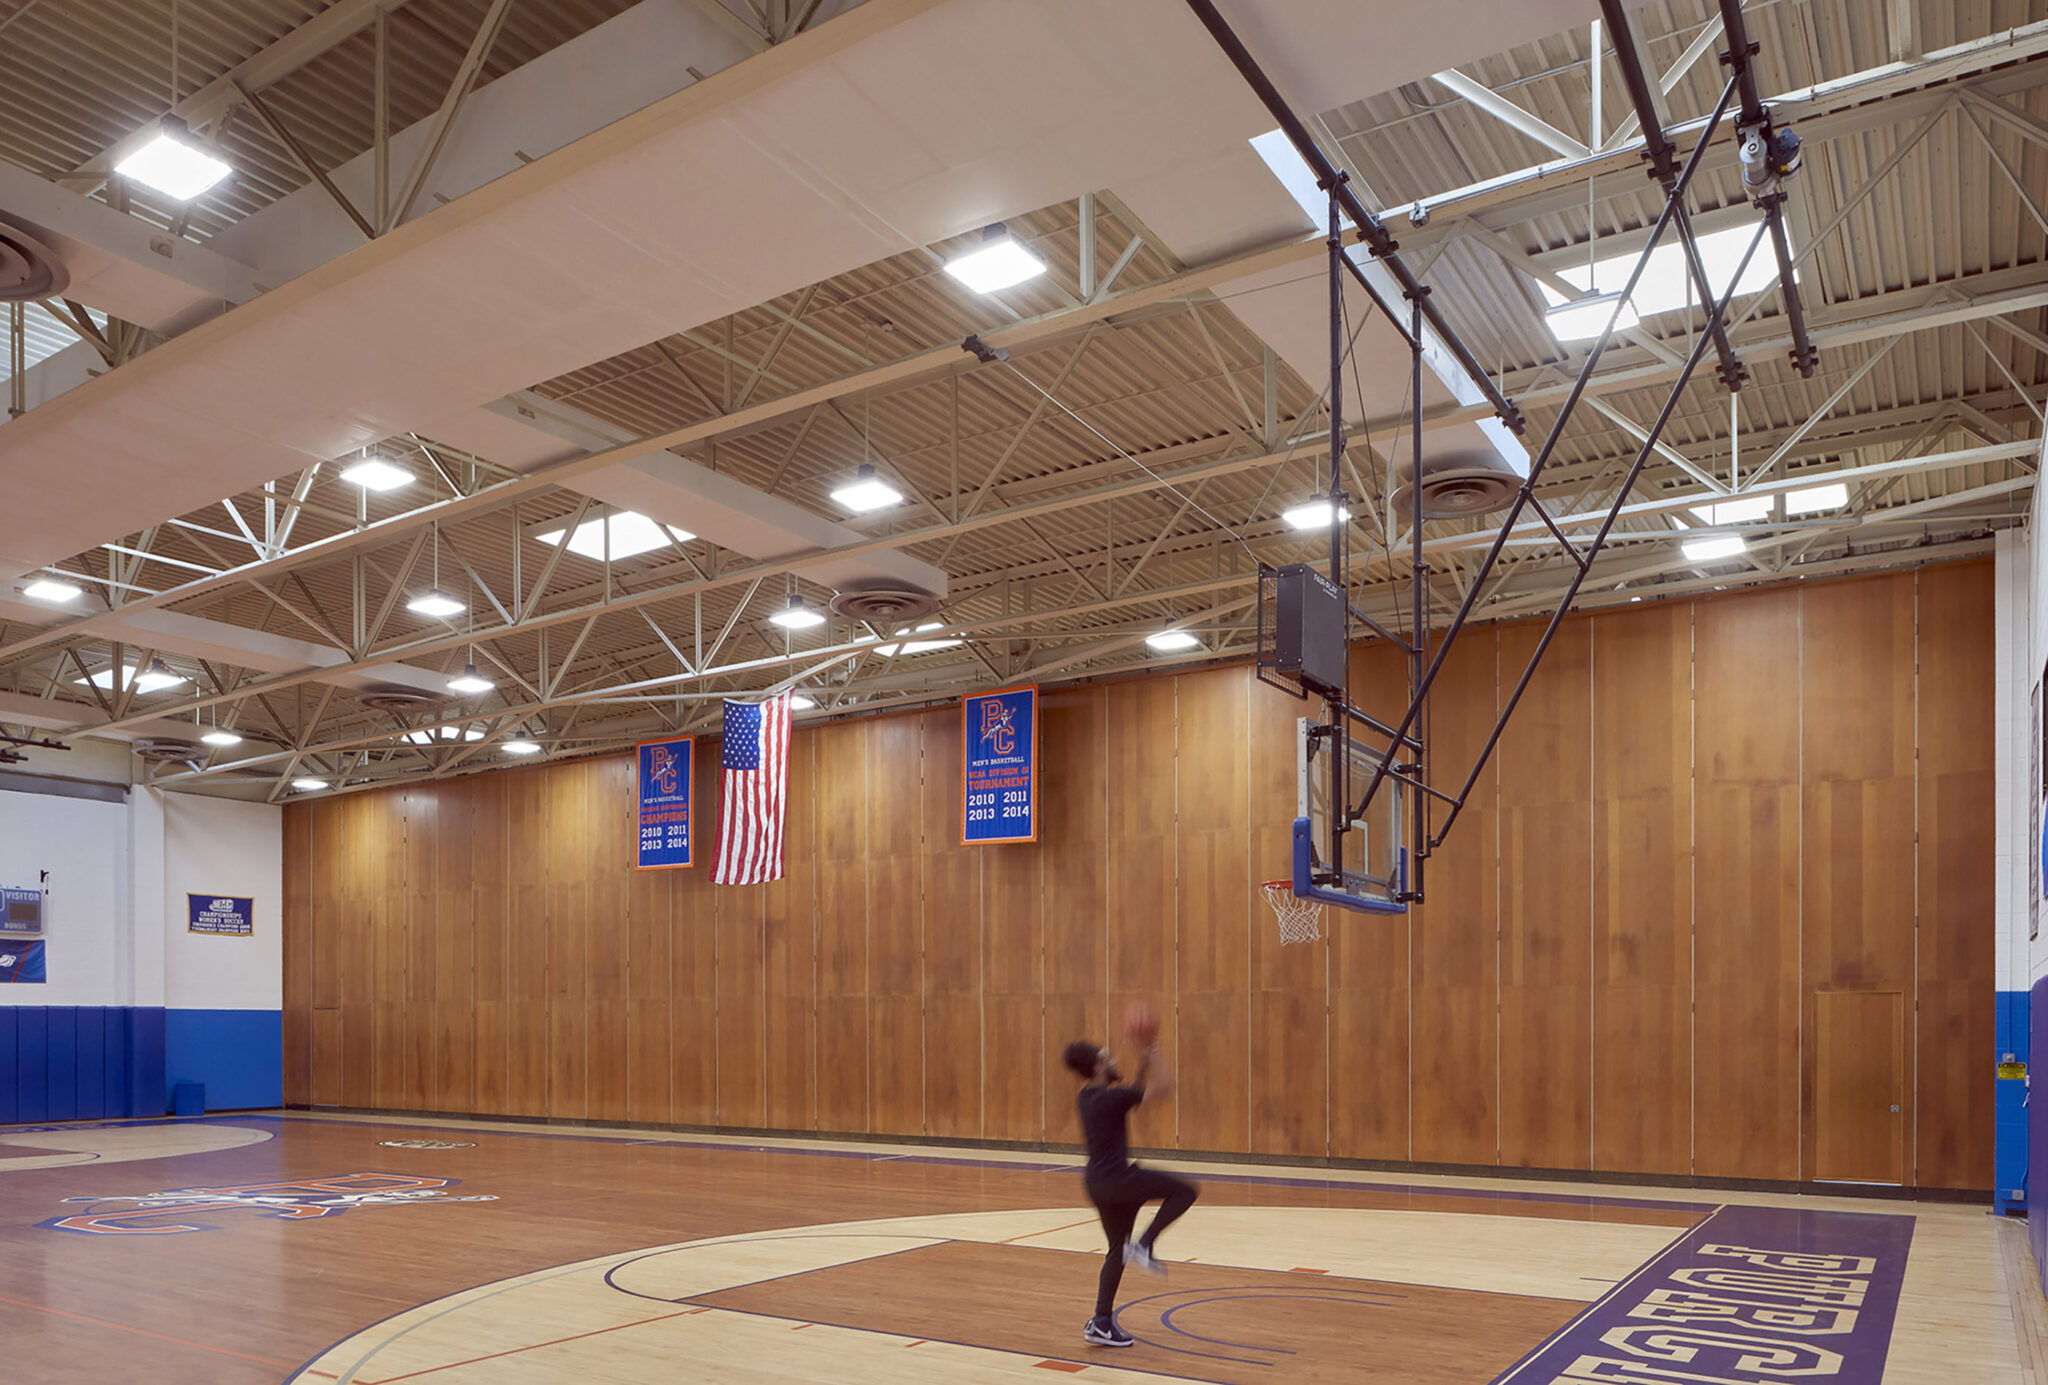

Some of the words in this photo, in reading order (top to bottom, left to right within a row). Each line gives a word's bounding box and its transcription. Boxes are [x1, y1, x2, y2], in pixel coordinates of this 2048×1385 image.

[972, 758, 989, 767] MEN'S
[990, 756, 1025, 766] BASKETBALL
[968, 769, 986, 779] NCAA
[988, 767, 1019, 778] DIVISION
[968, 776, 1029, 791] TOURNAMENT
[968, 793, 995, 807] 2010
[1003, 791, 1027, 803] 2011
[641, 811, 687, 825] CHAMPIONS
[968, 808, 995, 821] 2013
[1002, 805, 1029, 818] 2014
[641, 827, 662, 838] 2010
[667, 825, 686, 836] 2011
[641, 839, 662, 851] 2013
[667, 838, 687, 849] 2014
[6, 891, 40, 901] VISITOR
[199, 911, 242, 919] CHAMPIONSHIPS
